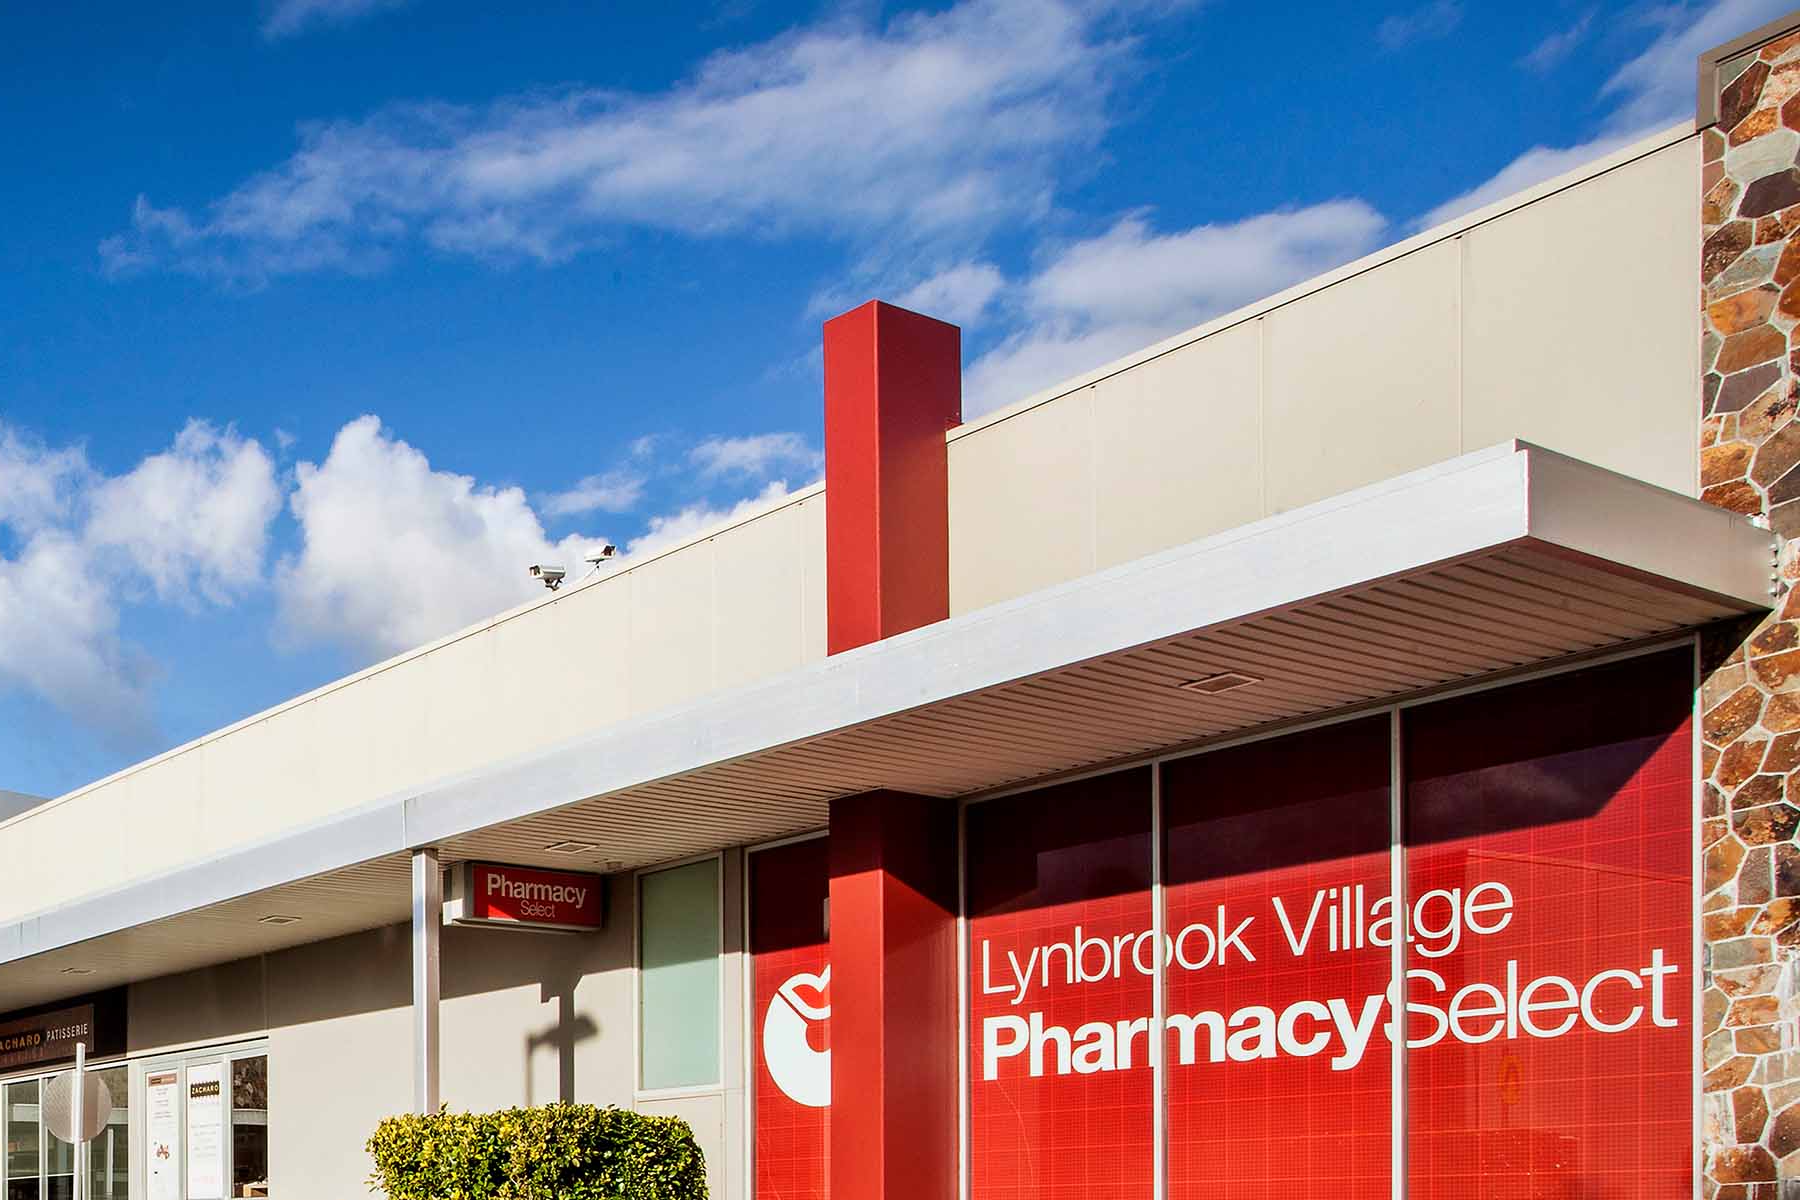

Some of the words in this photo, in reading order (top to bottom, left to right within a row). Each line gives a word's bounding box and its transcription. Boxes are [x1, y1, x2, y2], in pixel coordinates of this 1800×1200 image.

[487, 873, 587, 909] Pharmacy
[520, 899, 556, 918] Select
[982, 904, 1257, 1006] Lynbrook
[1272, 881, 1514, 958] Village
[46, 1023, 89, 1042] PATISSERIE
[191, 1084, 219, 1095] ZACHARO
